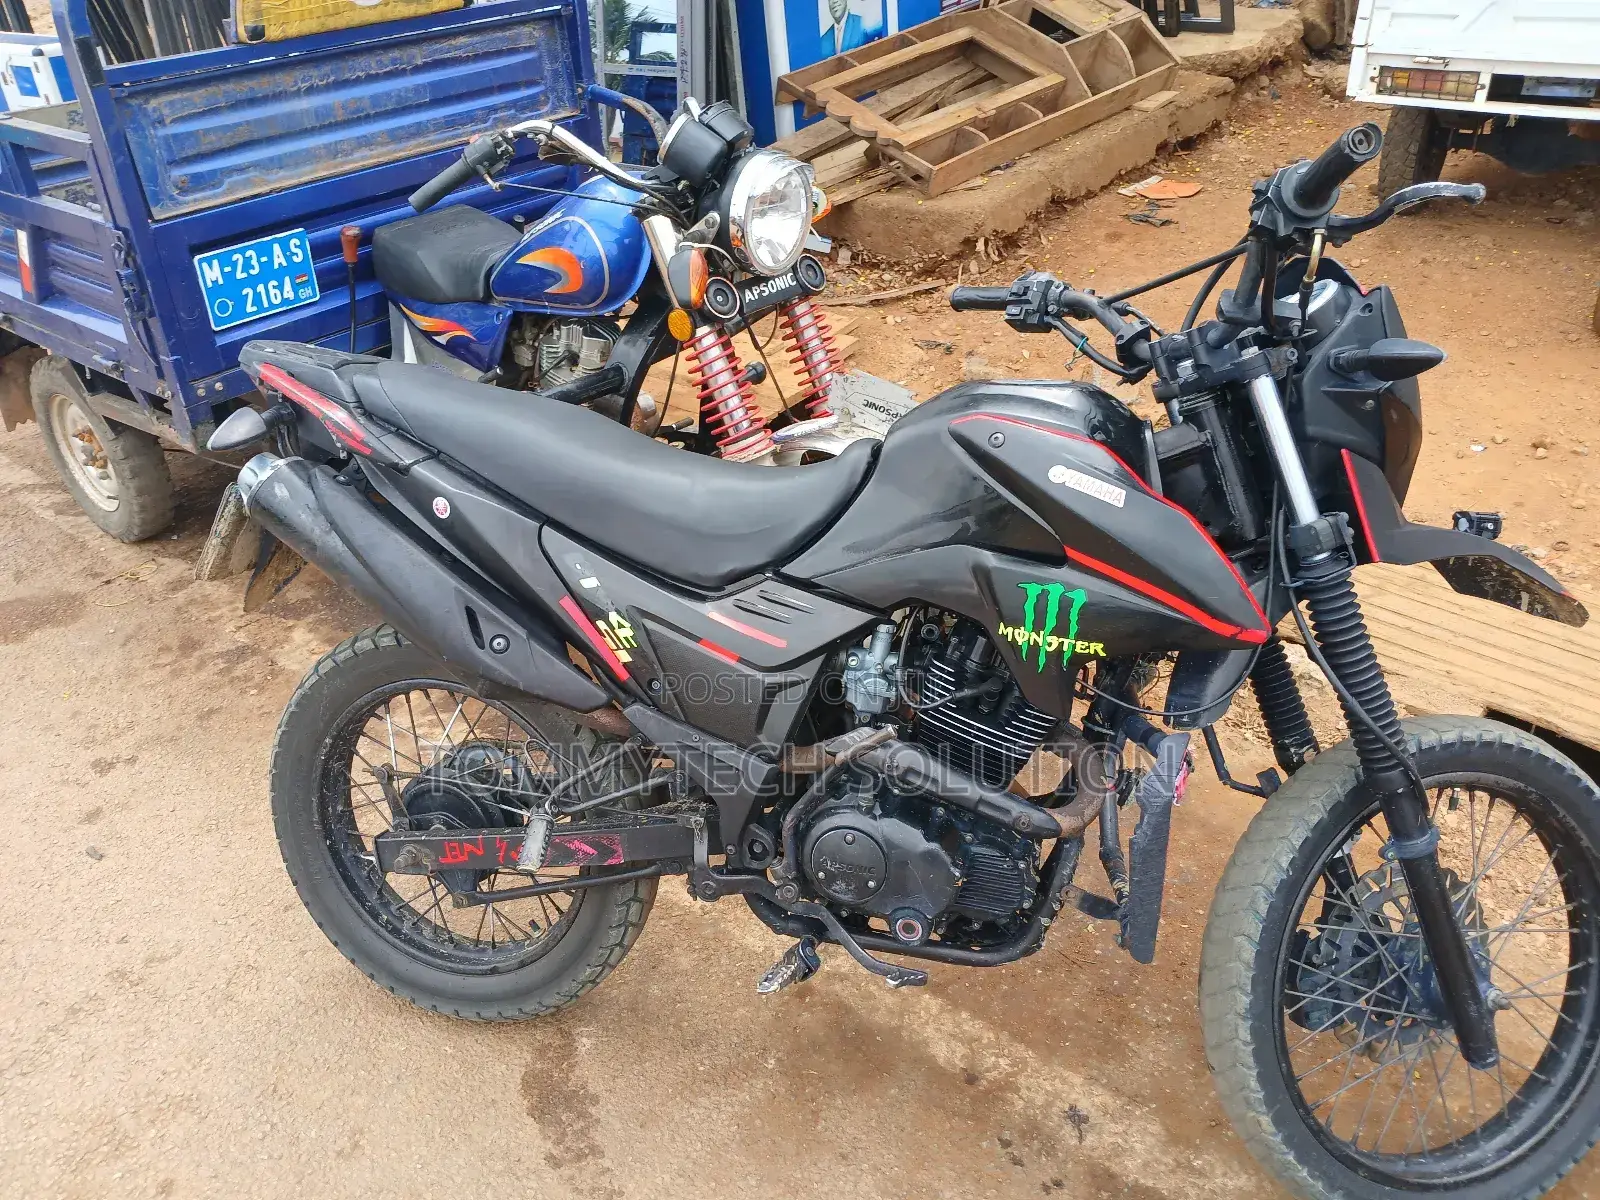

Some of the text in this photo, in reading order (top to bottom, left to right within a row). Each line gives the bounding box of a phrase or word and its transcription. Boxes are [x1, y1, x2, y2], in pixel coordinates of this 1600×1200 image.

[242, 276, 295, 313] 2164
[298, 286, 314, 300] GH
[745, 273, 797, 303] APSONIC
[1068, 472, 1124, 505] YAMAHA
[998, 622, 1107, 657] MONSTER
